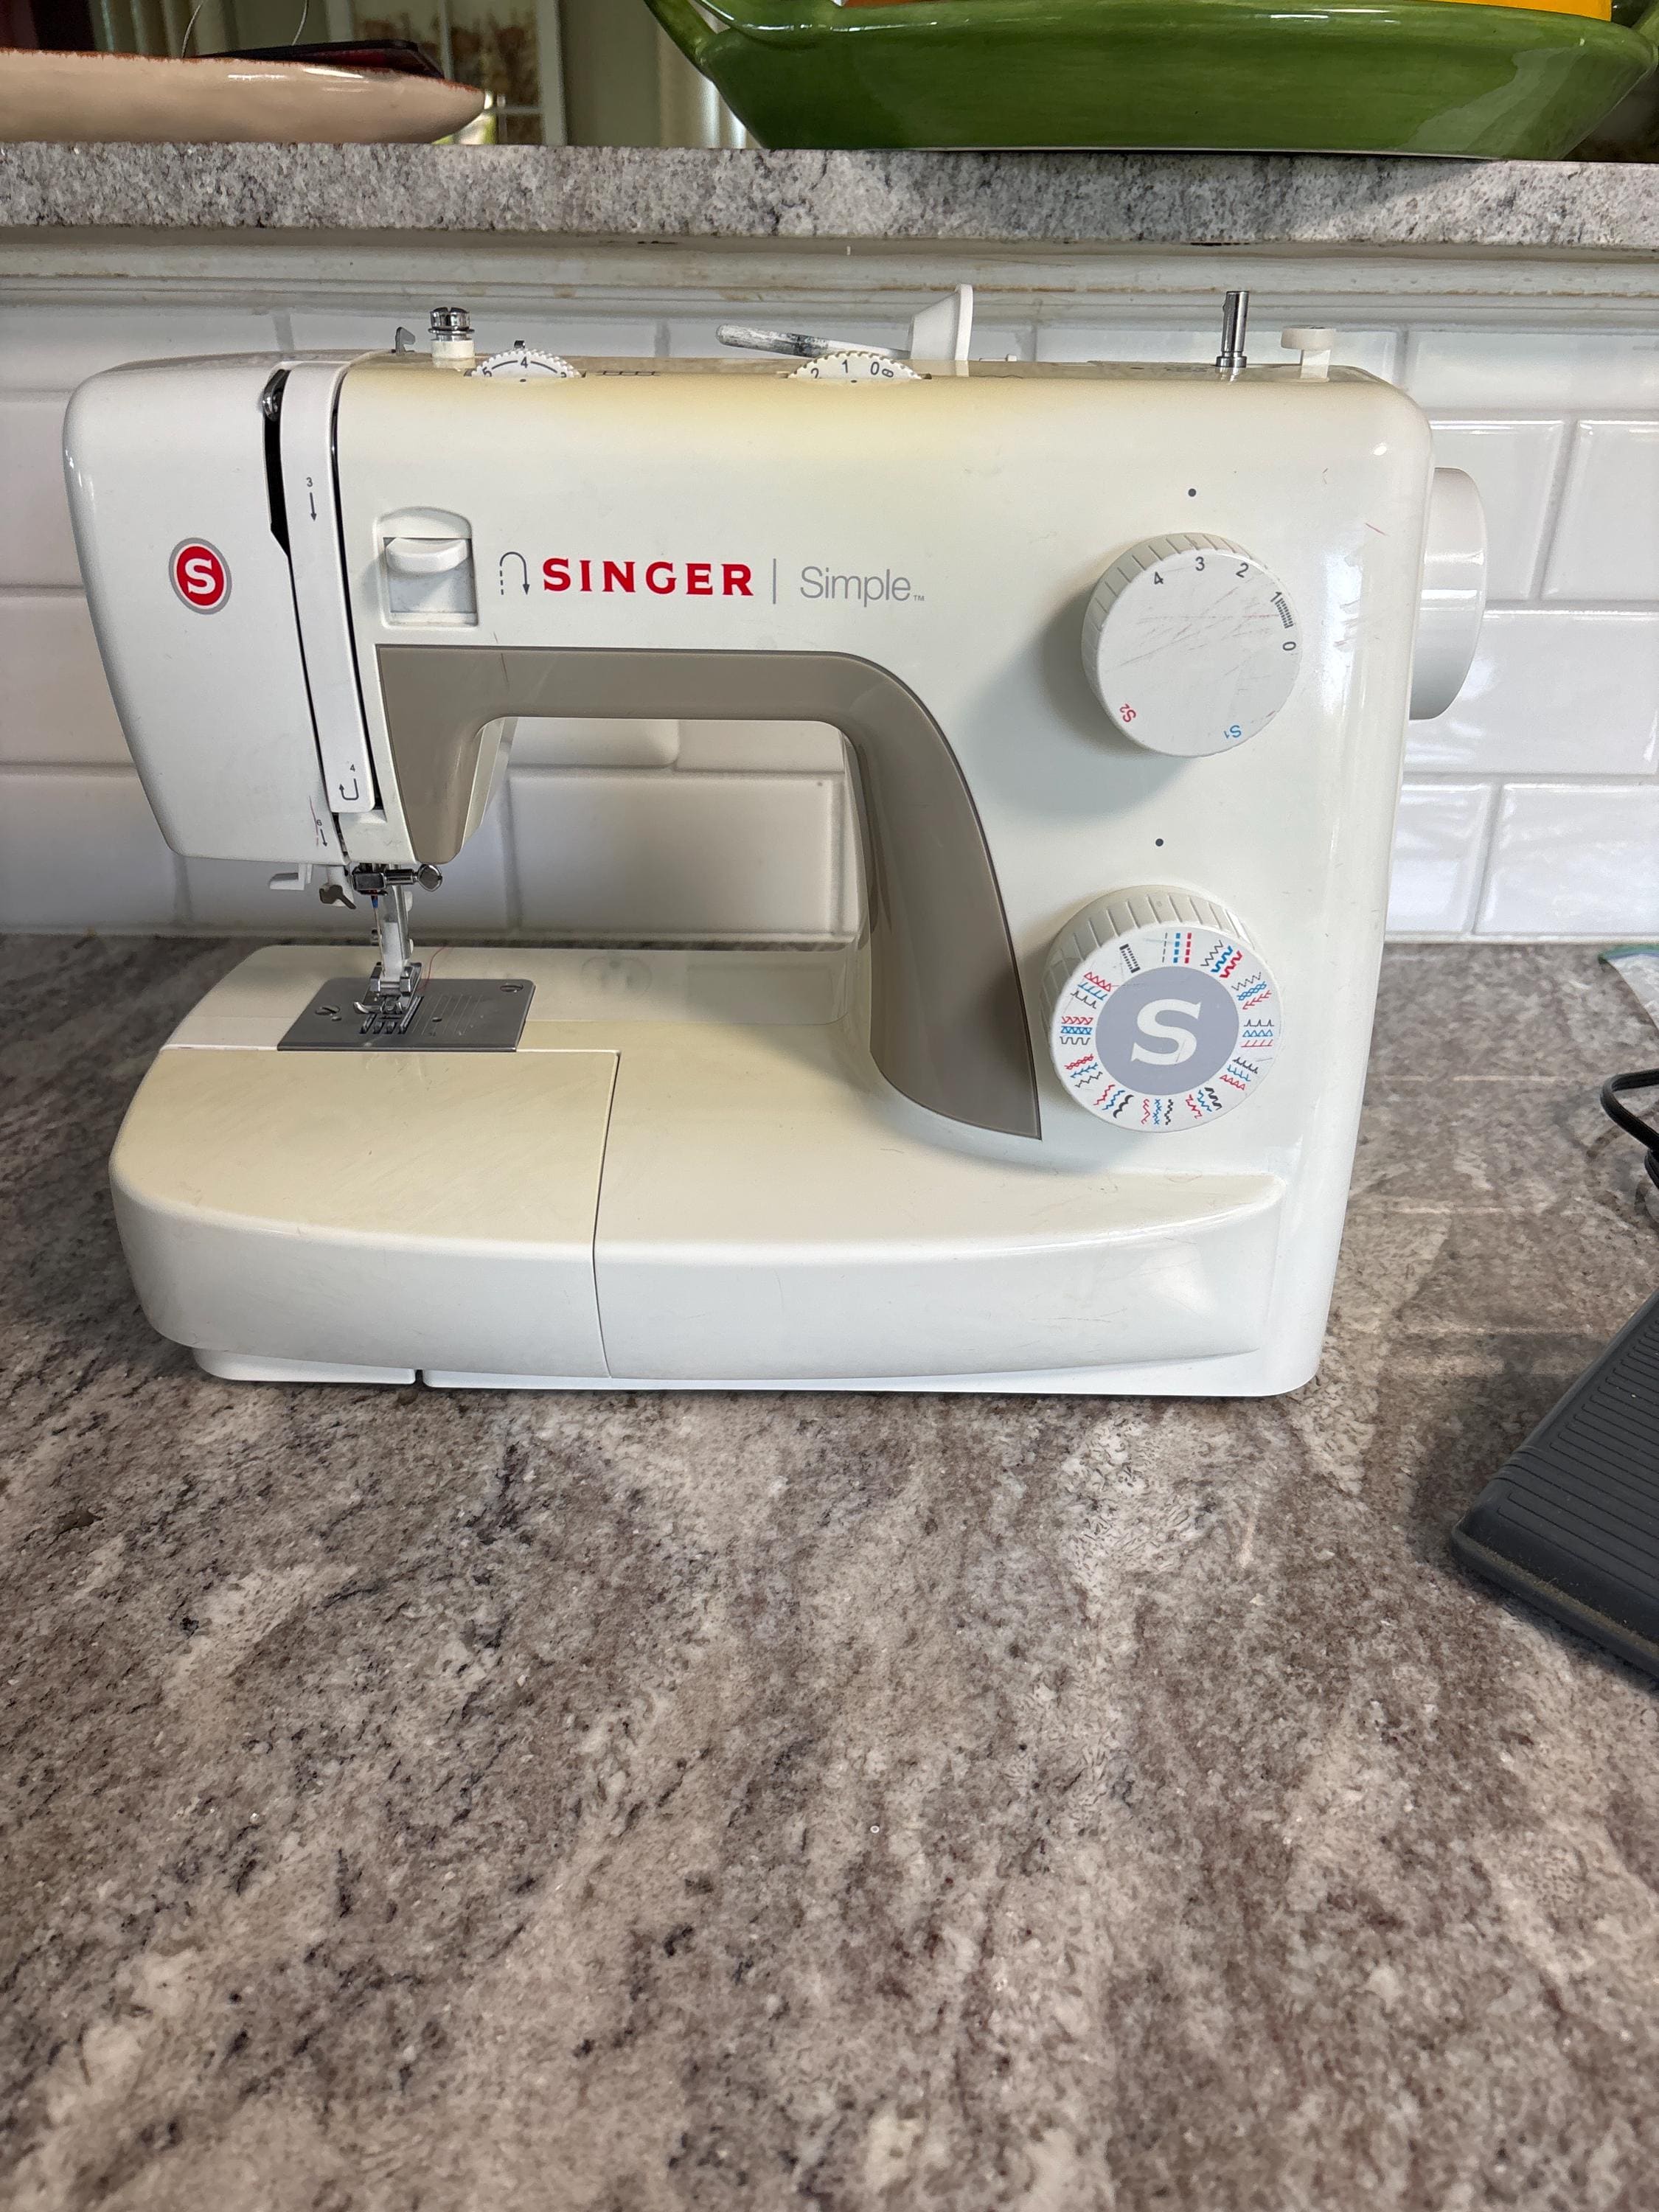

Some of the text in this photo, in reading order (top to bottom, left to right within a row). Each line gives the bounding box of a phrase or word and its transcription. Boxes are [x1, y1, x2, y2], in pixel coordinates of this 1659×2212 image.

[521, 357, 528, 369] 4
[842, 359, 849, 374] 1
[870, 361, 880, 375] 0
[306, 476, 313, 487] 3
[184, 559, 216, 594] S
[543, 557, 754, 596] SINGER
[1153, 556, 1296, 651] 4 3 2 1 0
[1119, 703, 1137, 723] S2
[1223, 725, 1242, 739] S1
[349, 764, 355, 772] 4
[1130, 998, 1202, 1065] S
